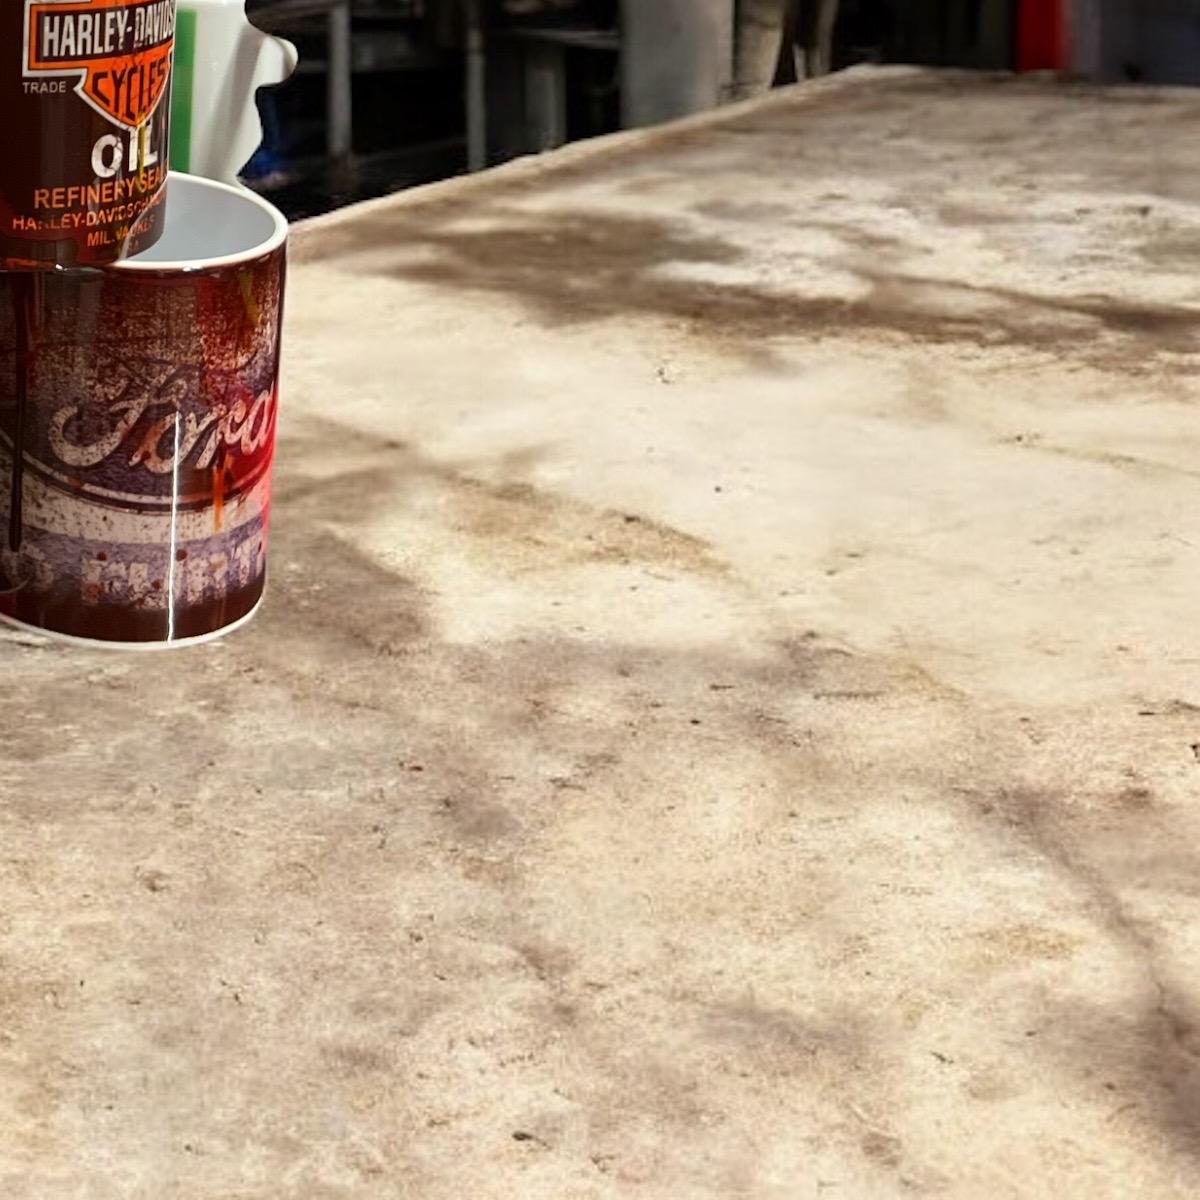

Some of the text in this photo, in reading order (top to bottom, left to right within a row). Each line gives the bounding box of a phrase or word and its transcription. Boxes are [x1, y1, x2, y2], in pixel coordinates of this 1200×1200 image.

[22, 80, 67, 94] TRADE
[92, 57, 166, 121] CYCLES
[90, 127, 158, 178] OIL
[34, 177, 136, 209] REFINERY
[47, 362, 275, 474] Ford
